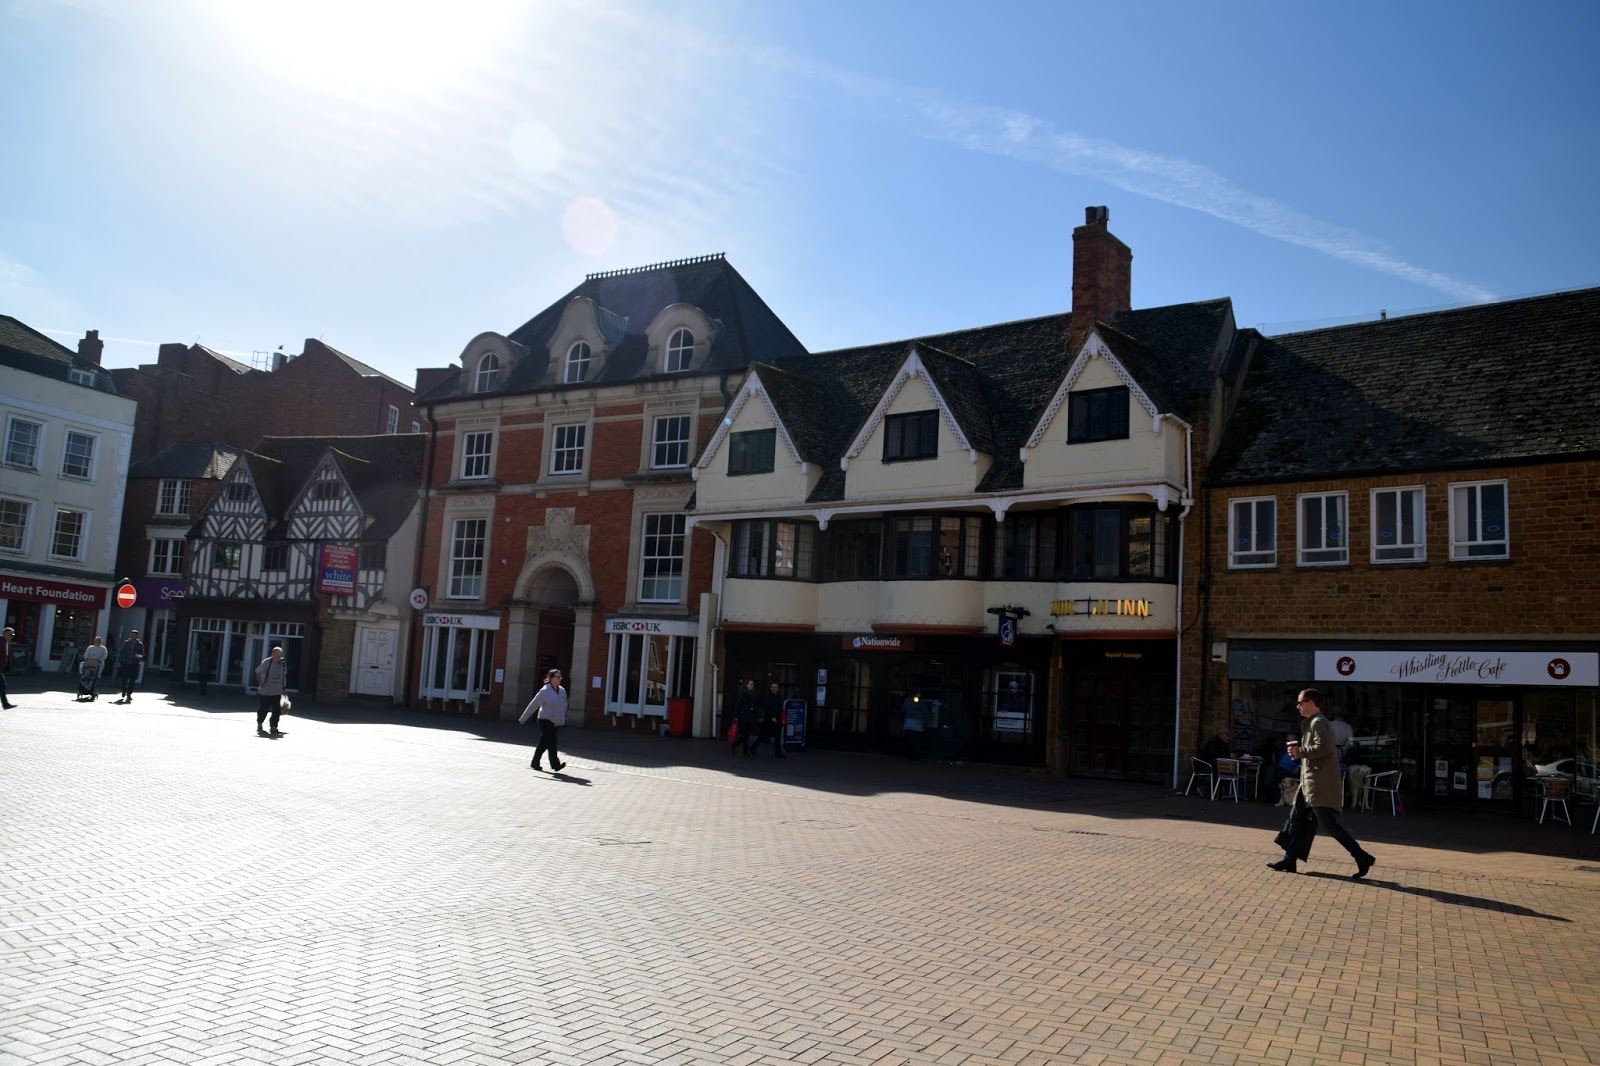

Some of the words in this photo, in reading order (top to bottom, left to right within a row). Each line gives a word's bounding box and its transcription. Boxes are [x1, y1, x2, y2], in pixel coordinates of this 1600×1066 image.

[325, 570, 351, 581] white
[2, 581, 33, 595] Heart
[35, 585, 95, 602] Foundation
[1117, 599, 1149, 616] INN
[425, 615, 440, 625] HSBC
[450, 616, 463, 625] UK
[613, 621, 632, 631] HSBC
[645, 622, 661, 632] UK
[861, 636, 901, 647] Nationwide
[1391, 653, 1447, 680] Whistling
[1436, 655, 1480, 681] Kettle
[1477, 657, 1506, 680] Cafe
